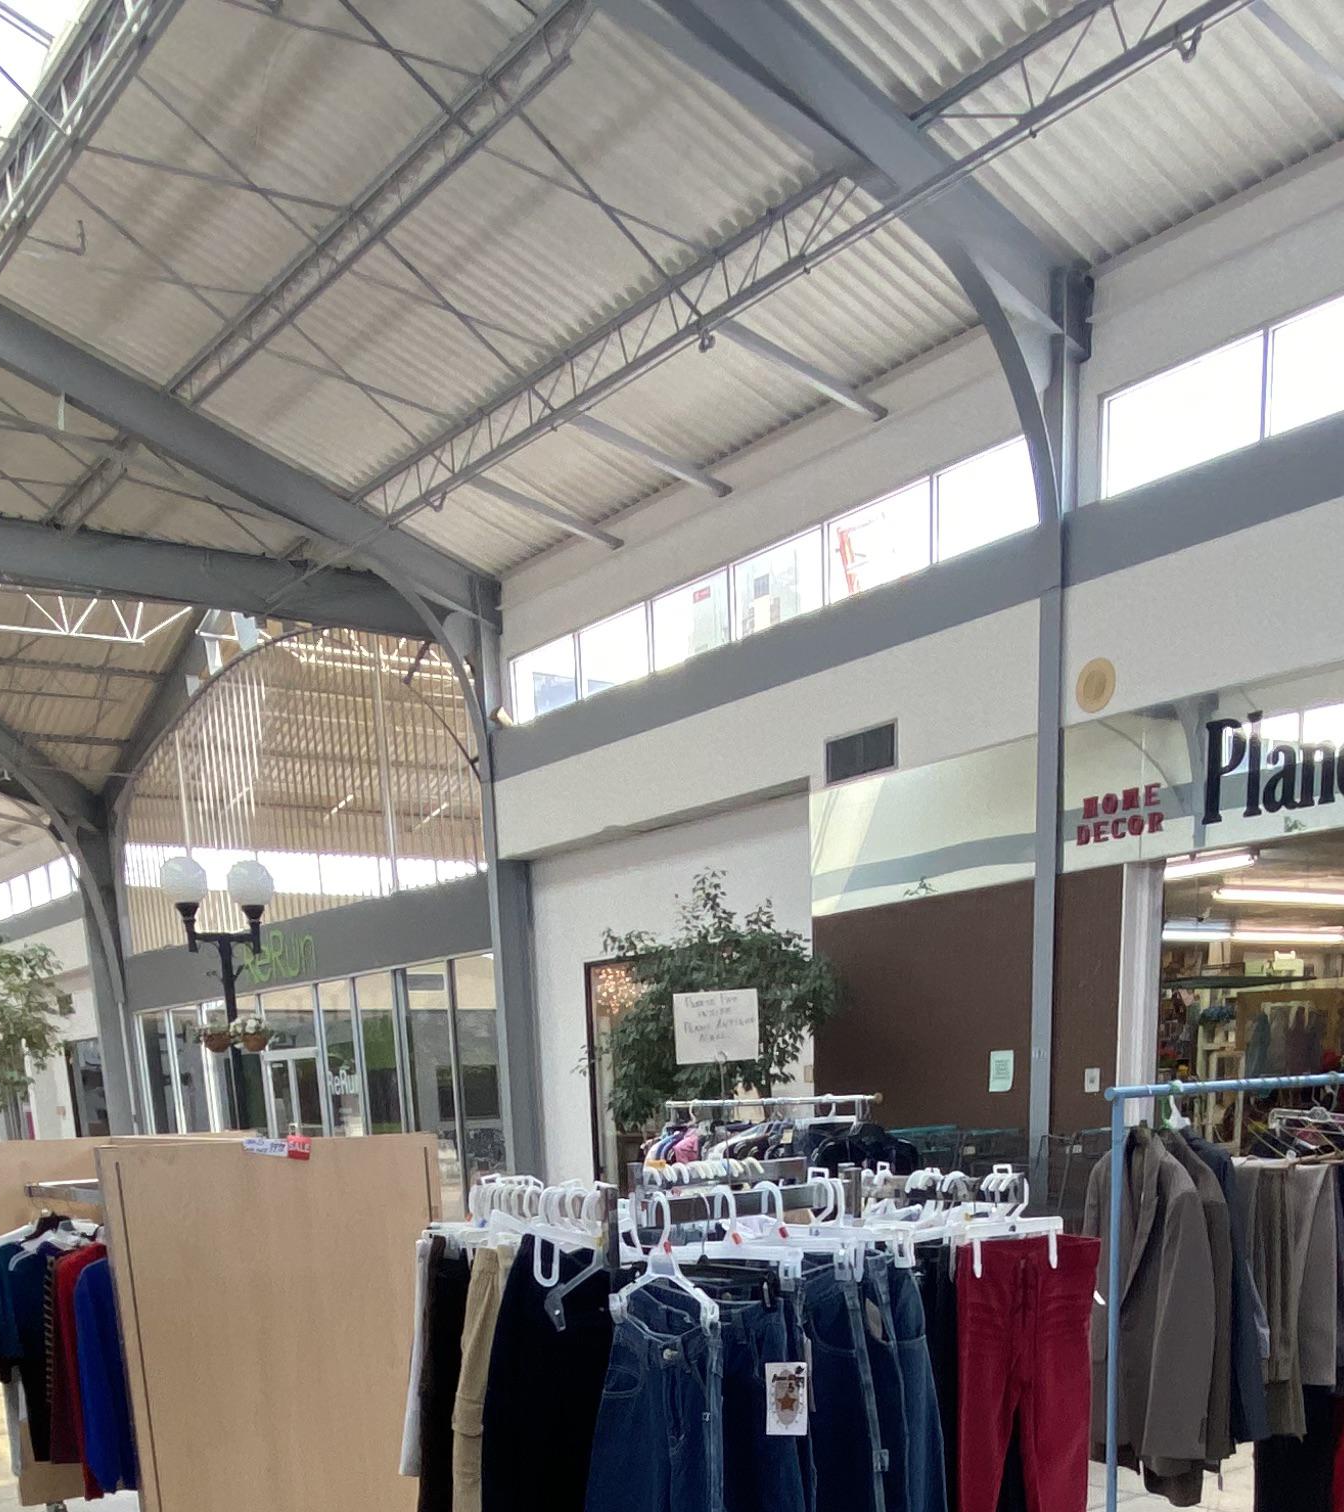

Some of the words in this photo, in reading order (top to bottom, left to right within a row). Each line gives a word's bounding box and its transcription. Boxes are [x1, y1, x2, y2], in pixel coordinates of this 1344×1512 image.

[1082, 782, 1162, 820] HOME
[1076, 812, 1165, 846] DECOR
[242, 928, 318, 985] ReRun
